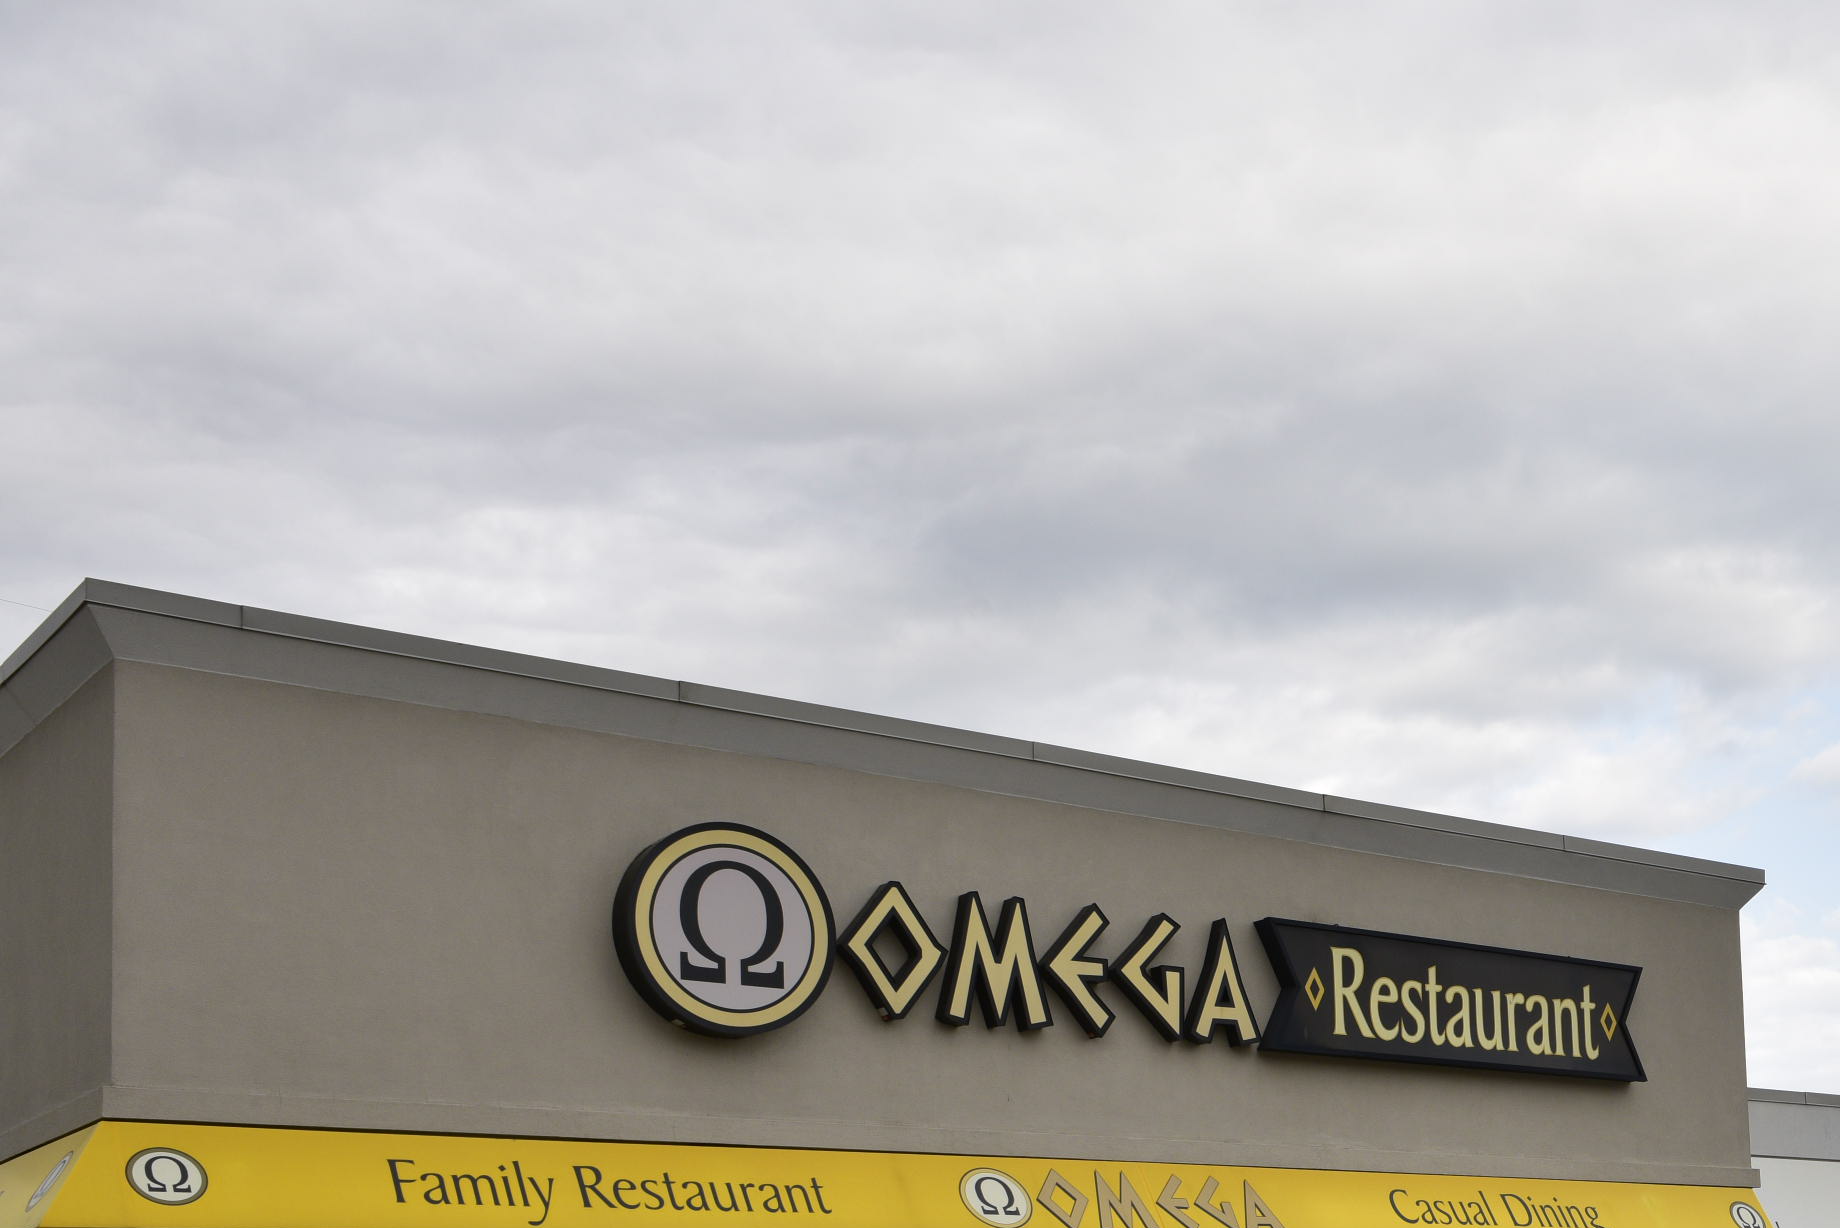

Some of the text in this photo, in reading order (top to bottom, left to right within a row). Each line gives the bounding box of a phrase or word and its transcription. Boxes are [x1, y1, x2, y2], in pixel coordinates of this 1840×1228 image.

[837, 881, 1261, 1047] OMEGA
[1330, 946, 1599, 1060] Restaurant
[386, 1159, 832, 1225] Family Restaurant
[1389, 1188, 1499, 1226] Casual
